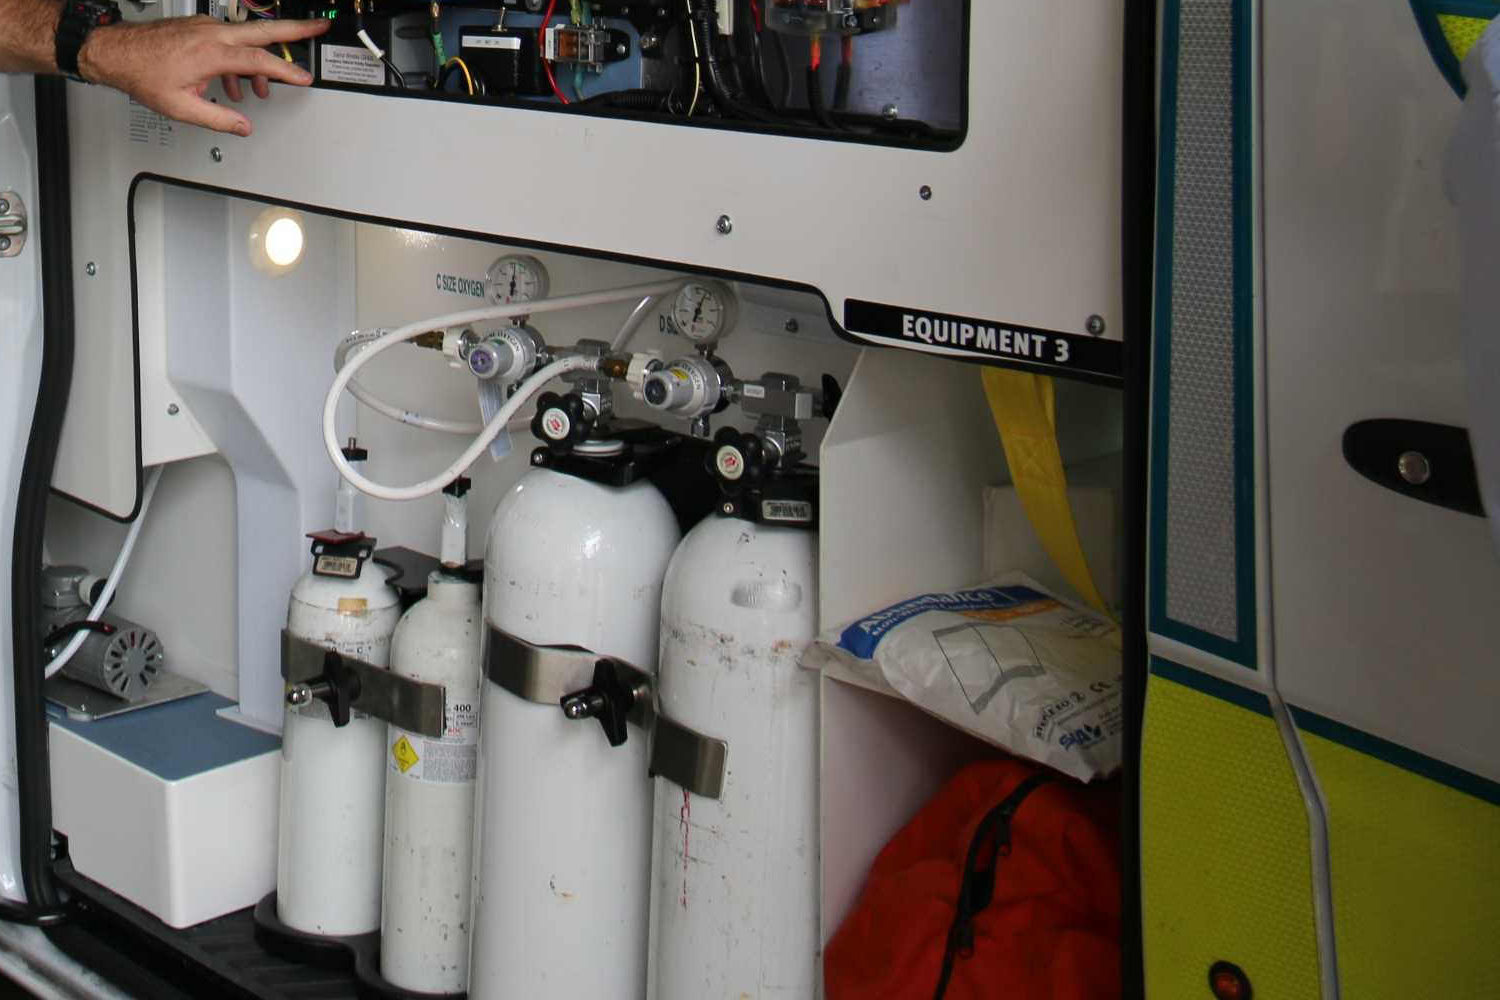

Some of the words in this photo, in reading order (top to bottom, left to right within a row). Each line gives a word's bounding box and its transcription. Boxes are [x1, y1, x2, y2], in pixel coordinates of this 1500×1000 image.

[436, 273, 441, 289] C
[442, 275, 457, 293] SIZE
[458, 277, 485, 298] OXYGEN
[902, 314, 1047, 358] EQUIPMENT
[1054, 338, 1070, 363] 3
[453, 703, 472, 713] 400
